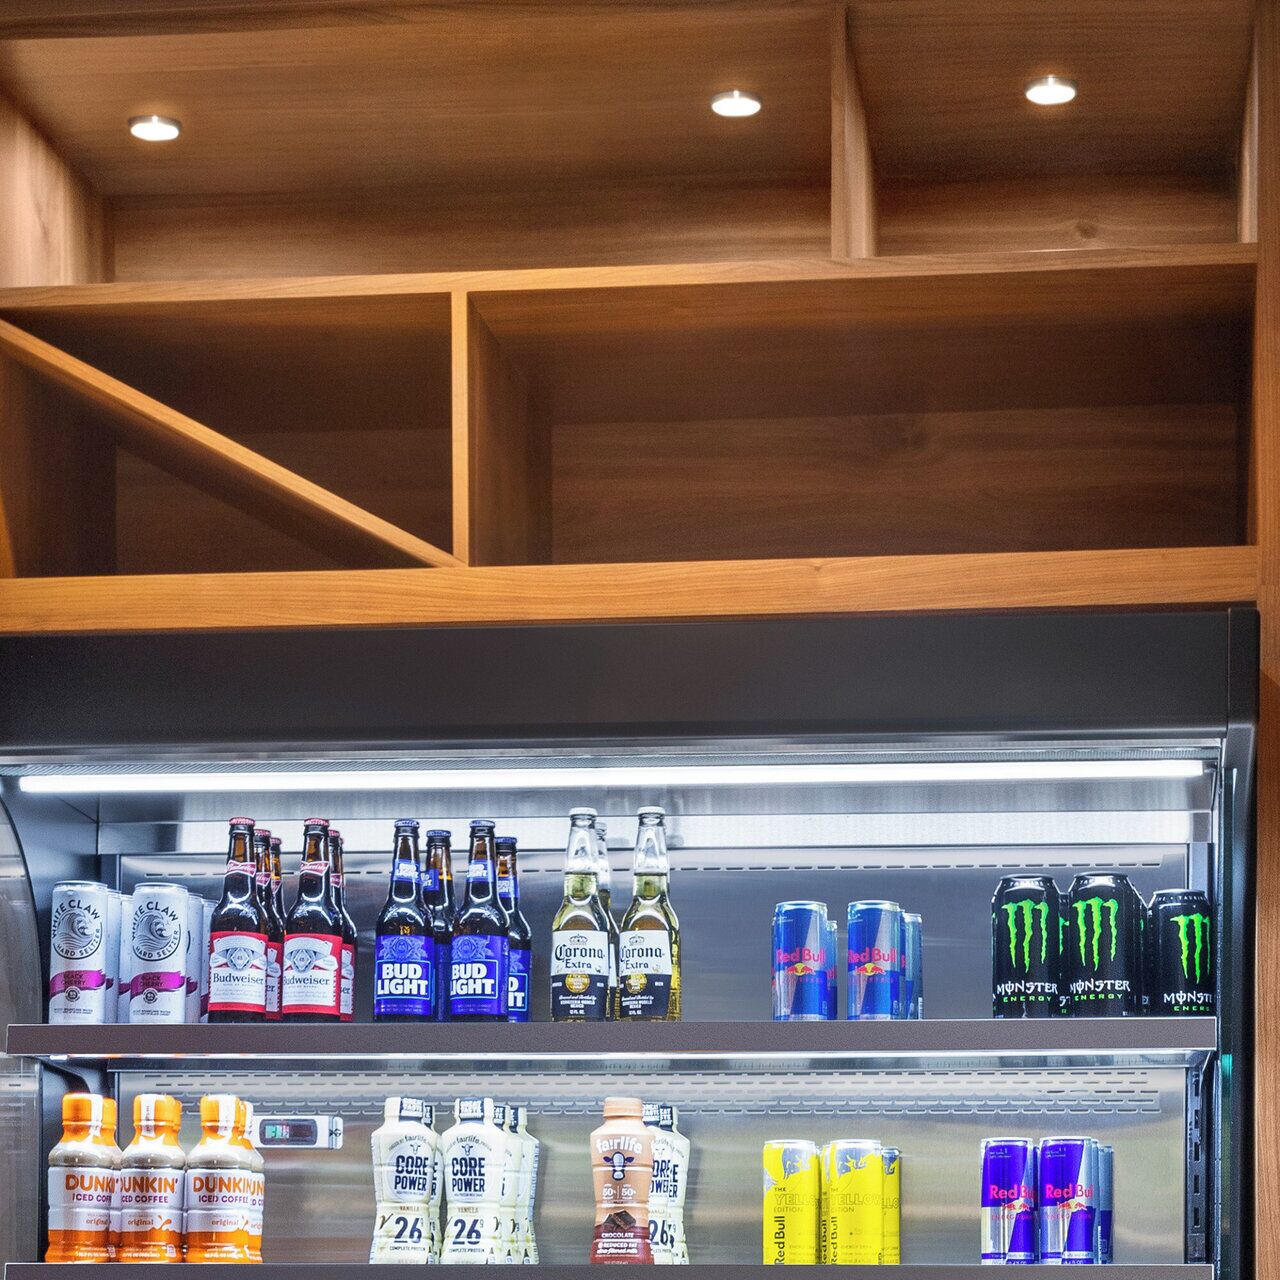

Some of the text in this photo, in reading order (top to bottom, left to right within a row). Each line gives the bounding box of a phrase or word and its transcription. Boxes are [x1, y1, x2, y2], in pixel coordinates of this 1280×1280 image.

[51, 900, 100, 939] WHITE CLAW
[146, 901, 179, 922] CLAW
[57, 928, 101, 957] HARD SELTZER
[135, 930, 179, 959] HARD SELTZER
[555, 944, 604, 961] Corona
[776, 948, 826, 964] Red Bull
[872, 948, 897, 963] Bull
[382, 963, 422, 979] BUD
[452, 963, 487, 979] BUD
[565, 960, 592, 969] Extra
[625, 961, 649, 969] Extra
[213, 973, 264, 985] Budweiser
[377, 978, 428, 996] LIGHT
[1070, 978, 1131, 993] MONSTER
[997, 981, 1058, 995] MONSTER
[1003, 995, 1052, 1003] ENERGY
[1074, 993, 1123, 1001] ENERGY
[596, 1136, 643, 1153] fairlife
[396, 1155, 429, 1175] CORE
[451, 1157, 486, 1177] CORE
[394, 1175, 427, 1192] POWER
[452, 1177, 485, 1193] POWER
[989, 1184, 1018, 1199] Red
[1045, 1184, 1073, 1198] Red
[72, 1193, 94, 1202] ICED
[134, 1195, 168, 1204] COFFEE
[198, 1195, 218, 1203] ICED
[774, 1215, 785, 1240] Bull
